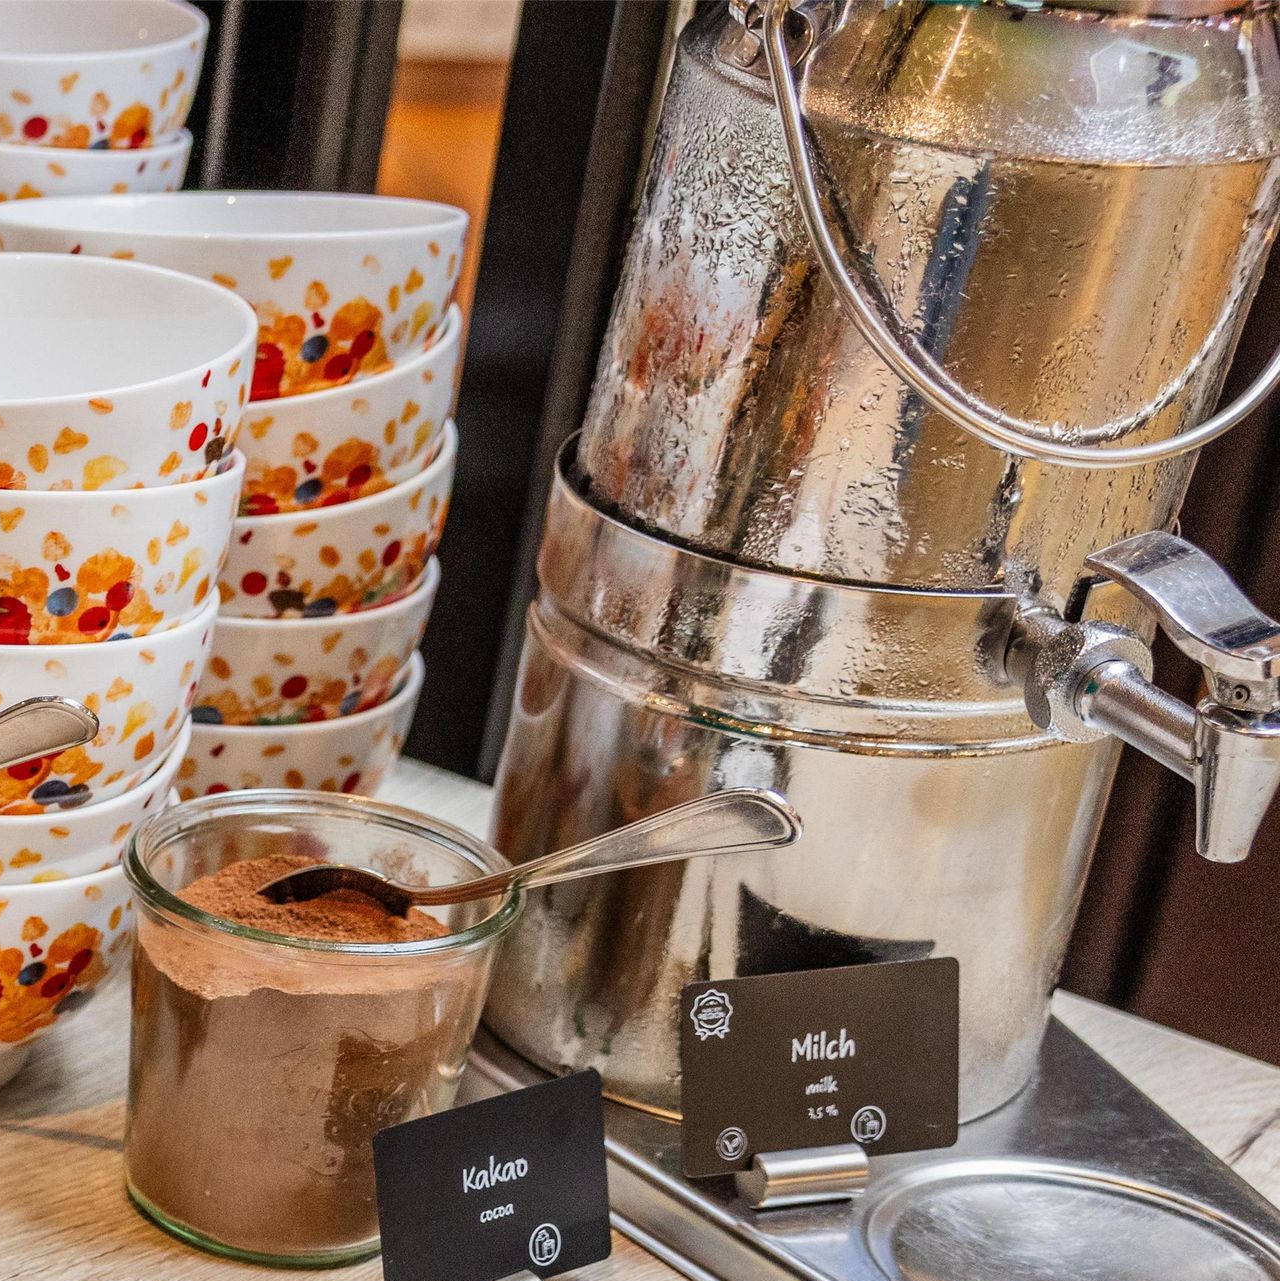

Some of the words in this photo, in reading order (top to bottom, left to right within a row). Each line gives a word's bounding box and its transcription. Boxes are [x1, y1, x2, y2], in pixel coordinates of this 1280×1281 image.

[791, 1028, 856, 1063] Milch
[805, 1075, 839, 1095] milk
[462, 1155, 529, 1194] Kakao
[479, 1203, 515, 1224] cocoa
